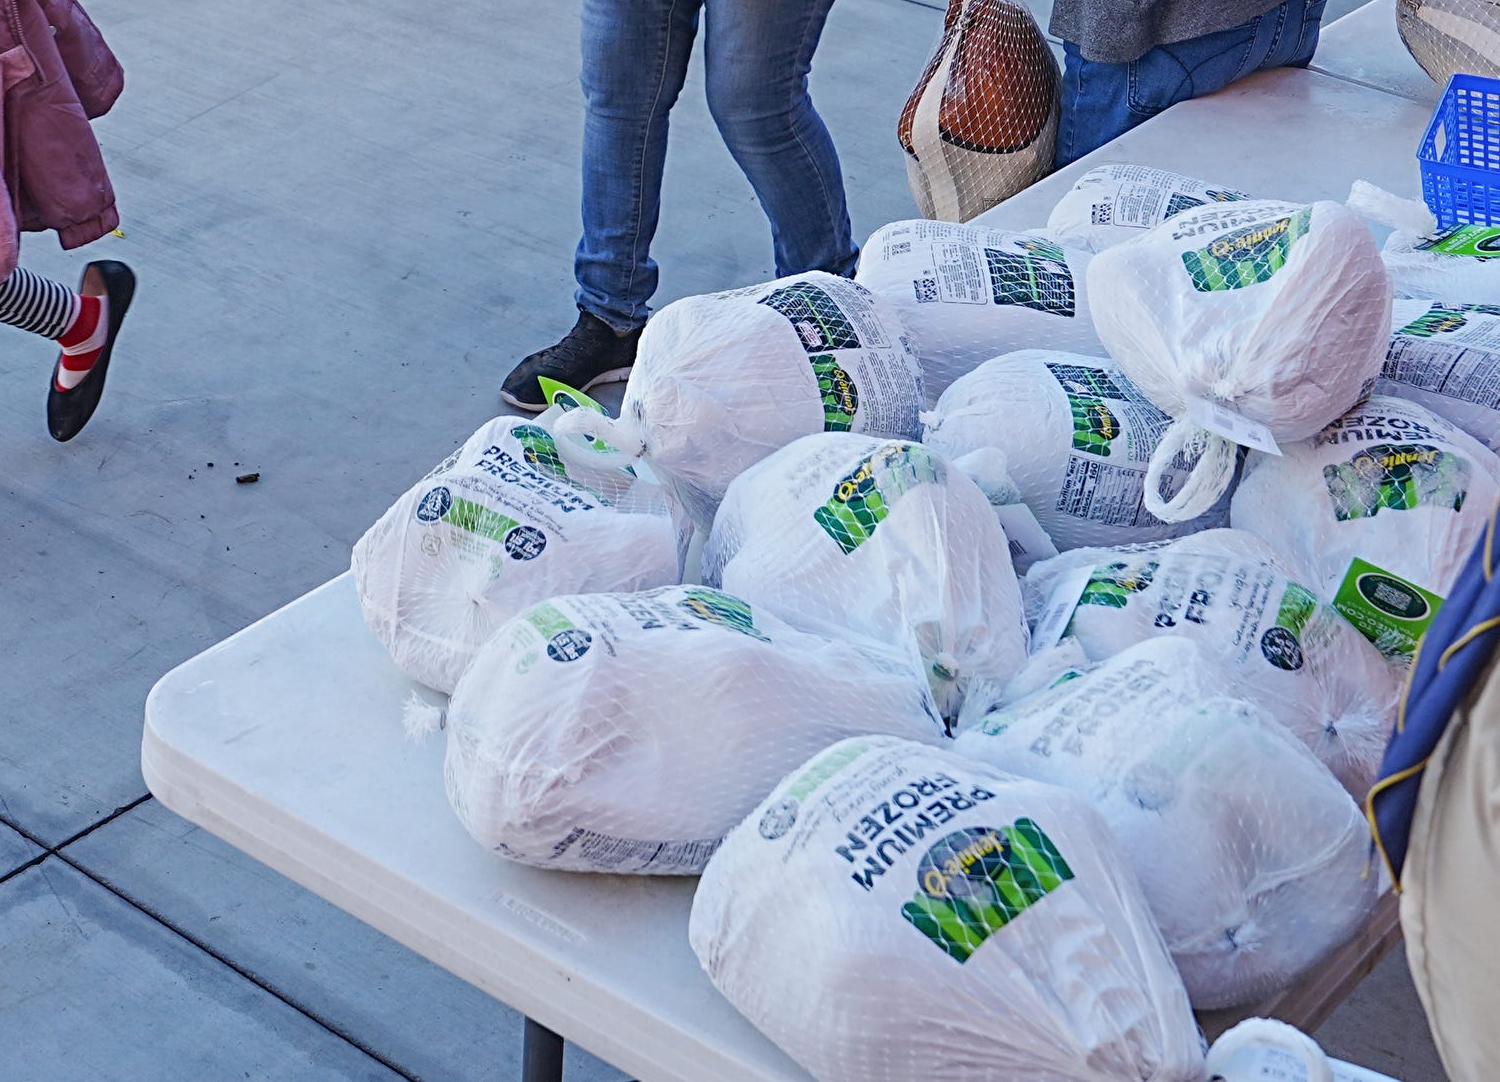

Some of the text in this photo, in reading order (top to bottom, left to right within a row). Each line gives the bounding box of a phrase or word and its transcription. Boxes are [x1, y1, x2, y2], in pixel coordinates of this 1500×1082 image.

[474, 459, 576, 513] FROZEN
[482, 445, 595, 511] PREMIUM
[1088, 462, 1098, 480] 160
[835, 772, 960, 863] FROZEN
[852, 784, 996, 892] PREMIUM
